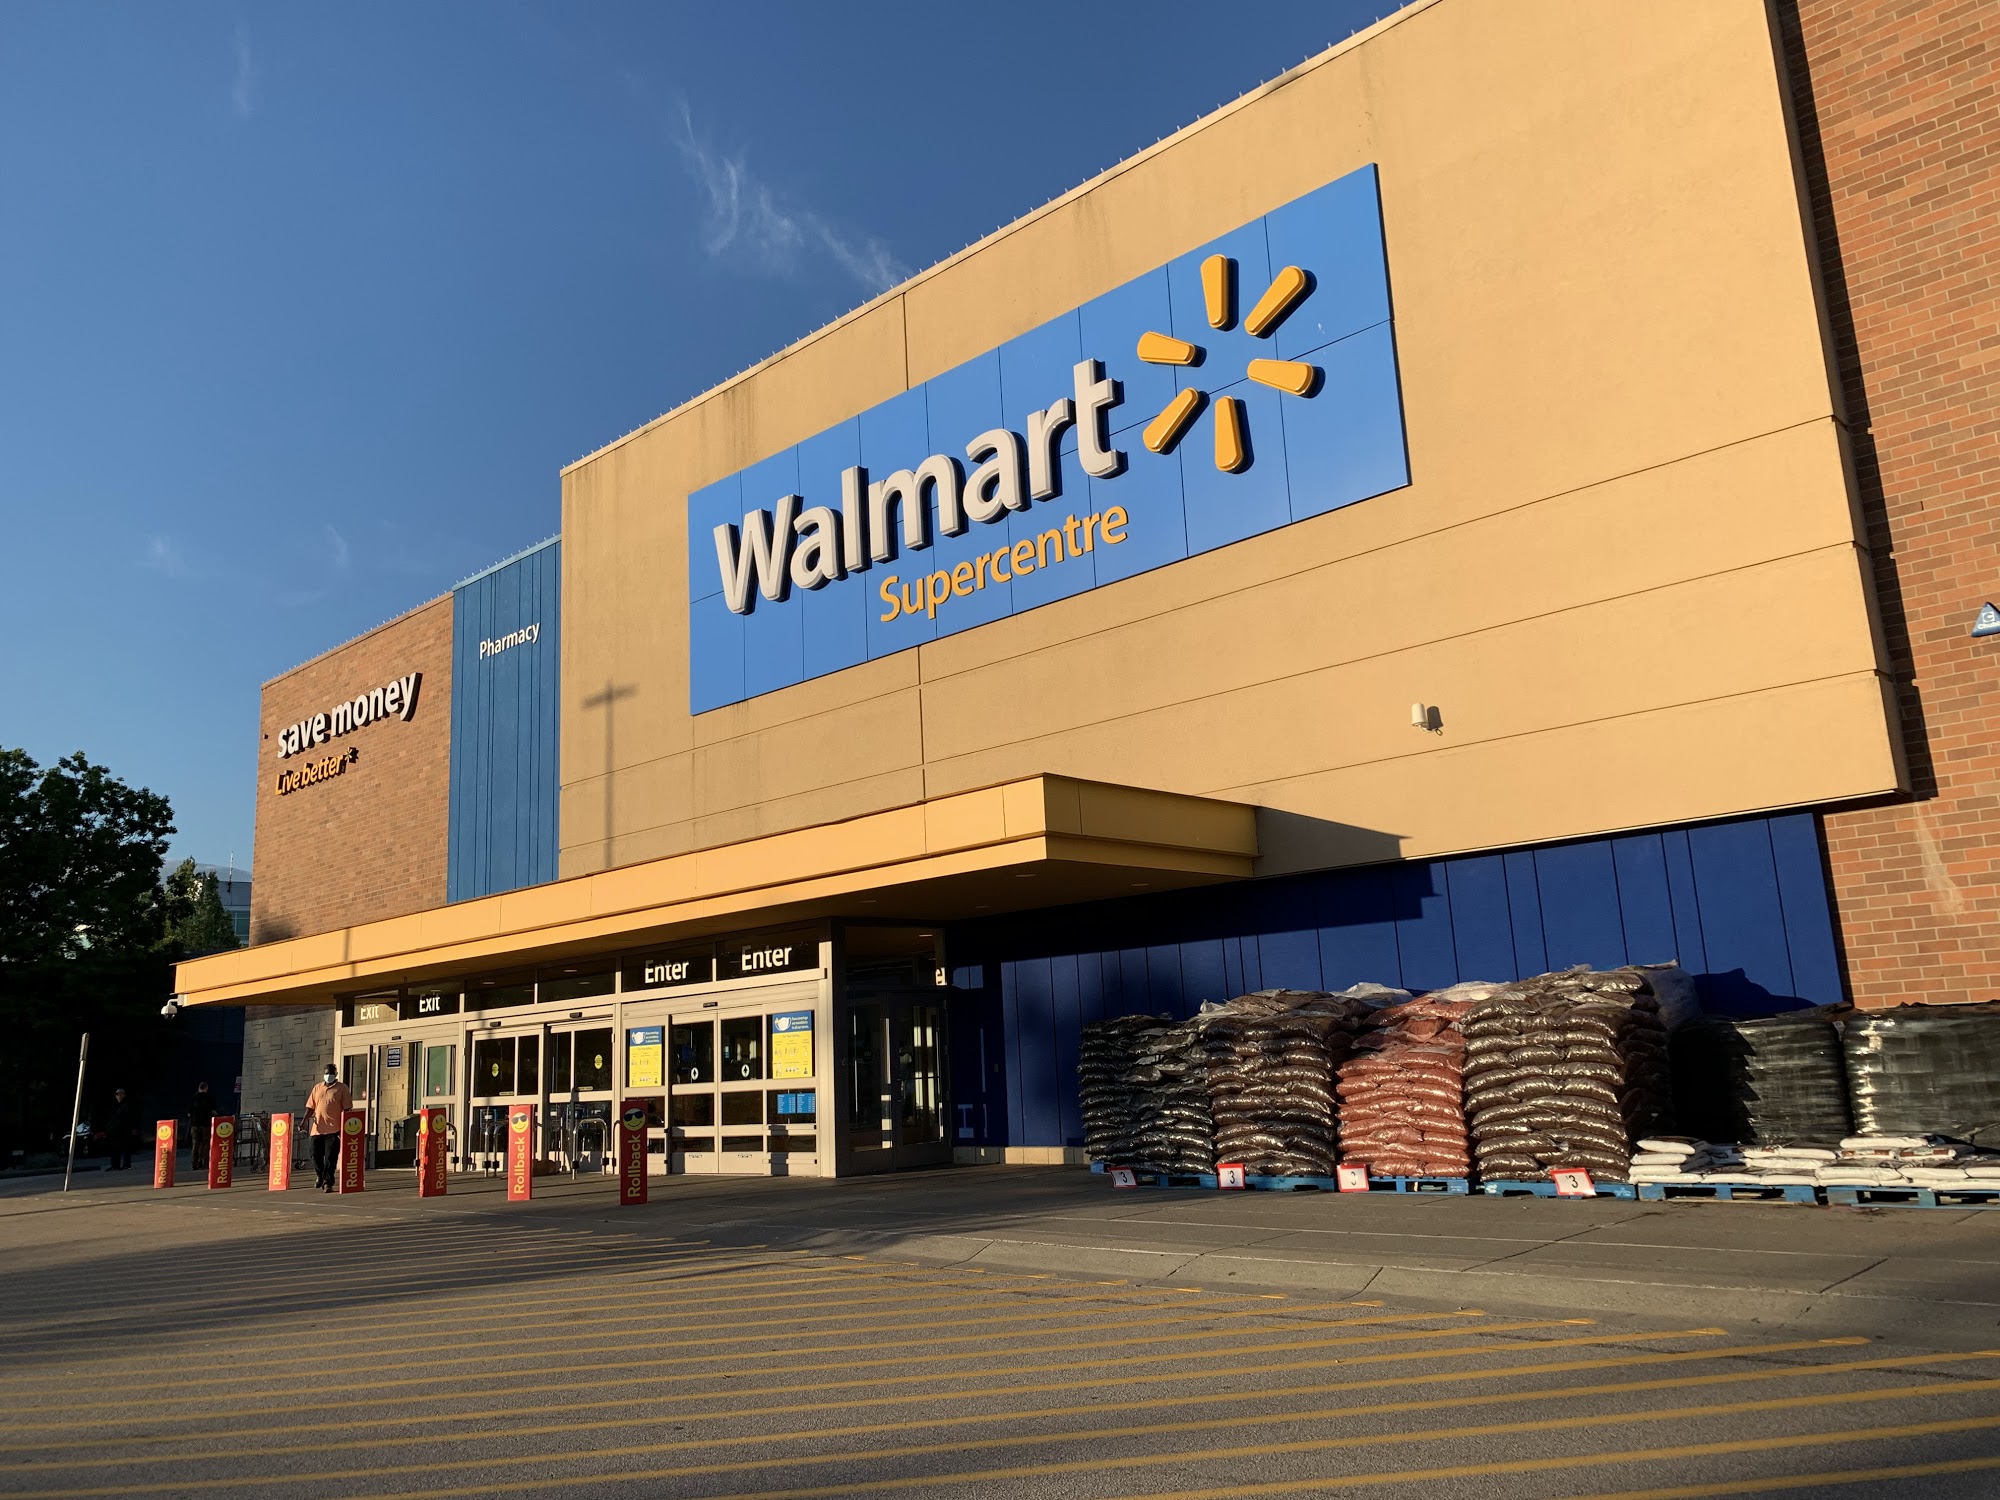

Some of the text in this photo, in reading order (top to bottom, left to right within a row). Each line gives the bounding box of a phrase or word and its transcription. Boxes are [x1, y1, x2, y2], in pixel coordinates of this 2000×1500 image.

[713, 358, 1127, 615] Walmart
[879, 504, 1129, 622] Supercentre
[479, 622, 540, 660] Pharmacy
[277, 672, 420, 759] save money
[275, 754, 344, 796] Live better
[644, 959, 690, 984] Enter
[741, 944, 793, 971] Enter
[360, 1004, 380, 1021] Exit
[419, 993, 441, 1013] Exit
[157, 1142, 168, 1184] Rollback
[217, 1139, 230, 1184] Rollback
[272, 1138, 284, 1186] Rollback
[346, 1137, 359, 1188] Rollback
[435, 1136, 445, 1190] Rollback
[513, 1136, 525, 1194] Rollback
[627, 1133, 641, 1198] Rollback
